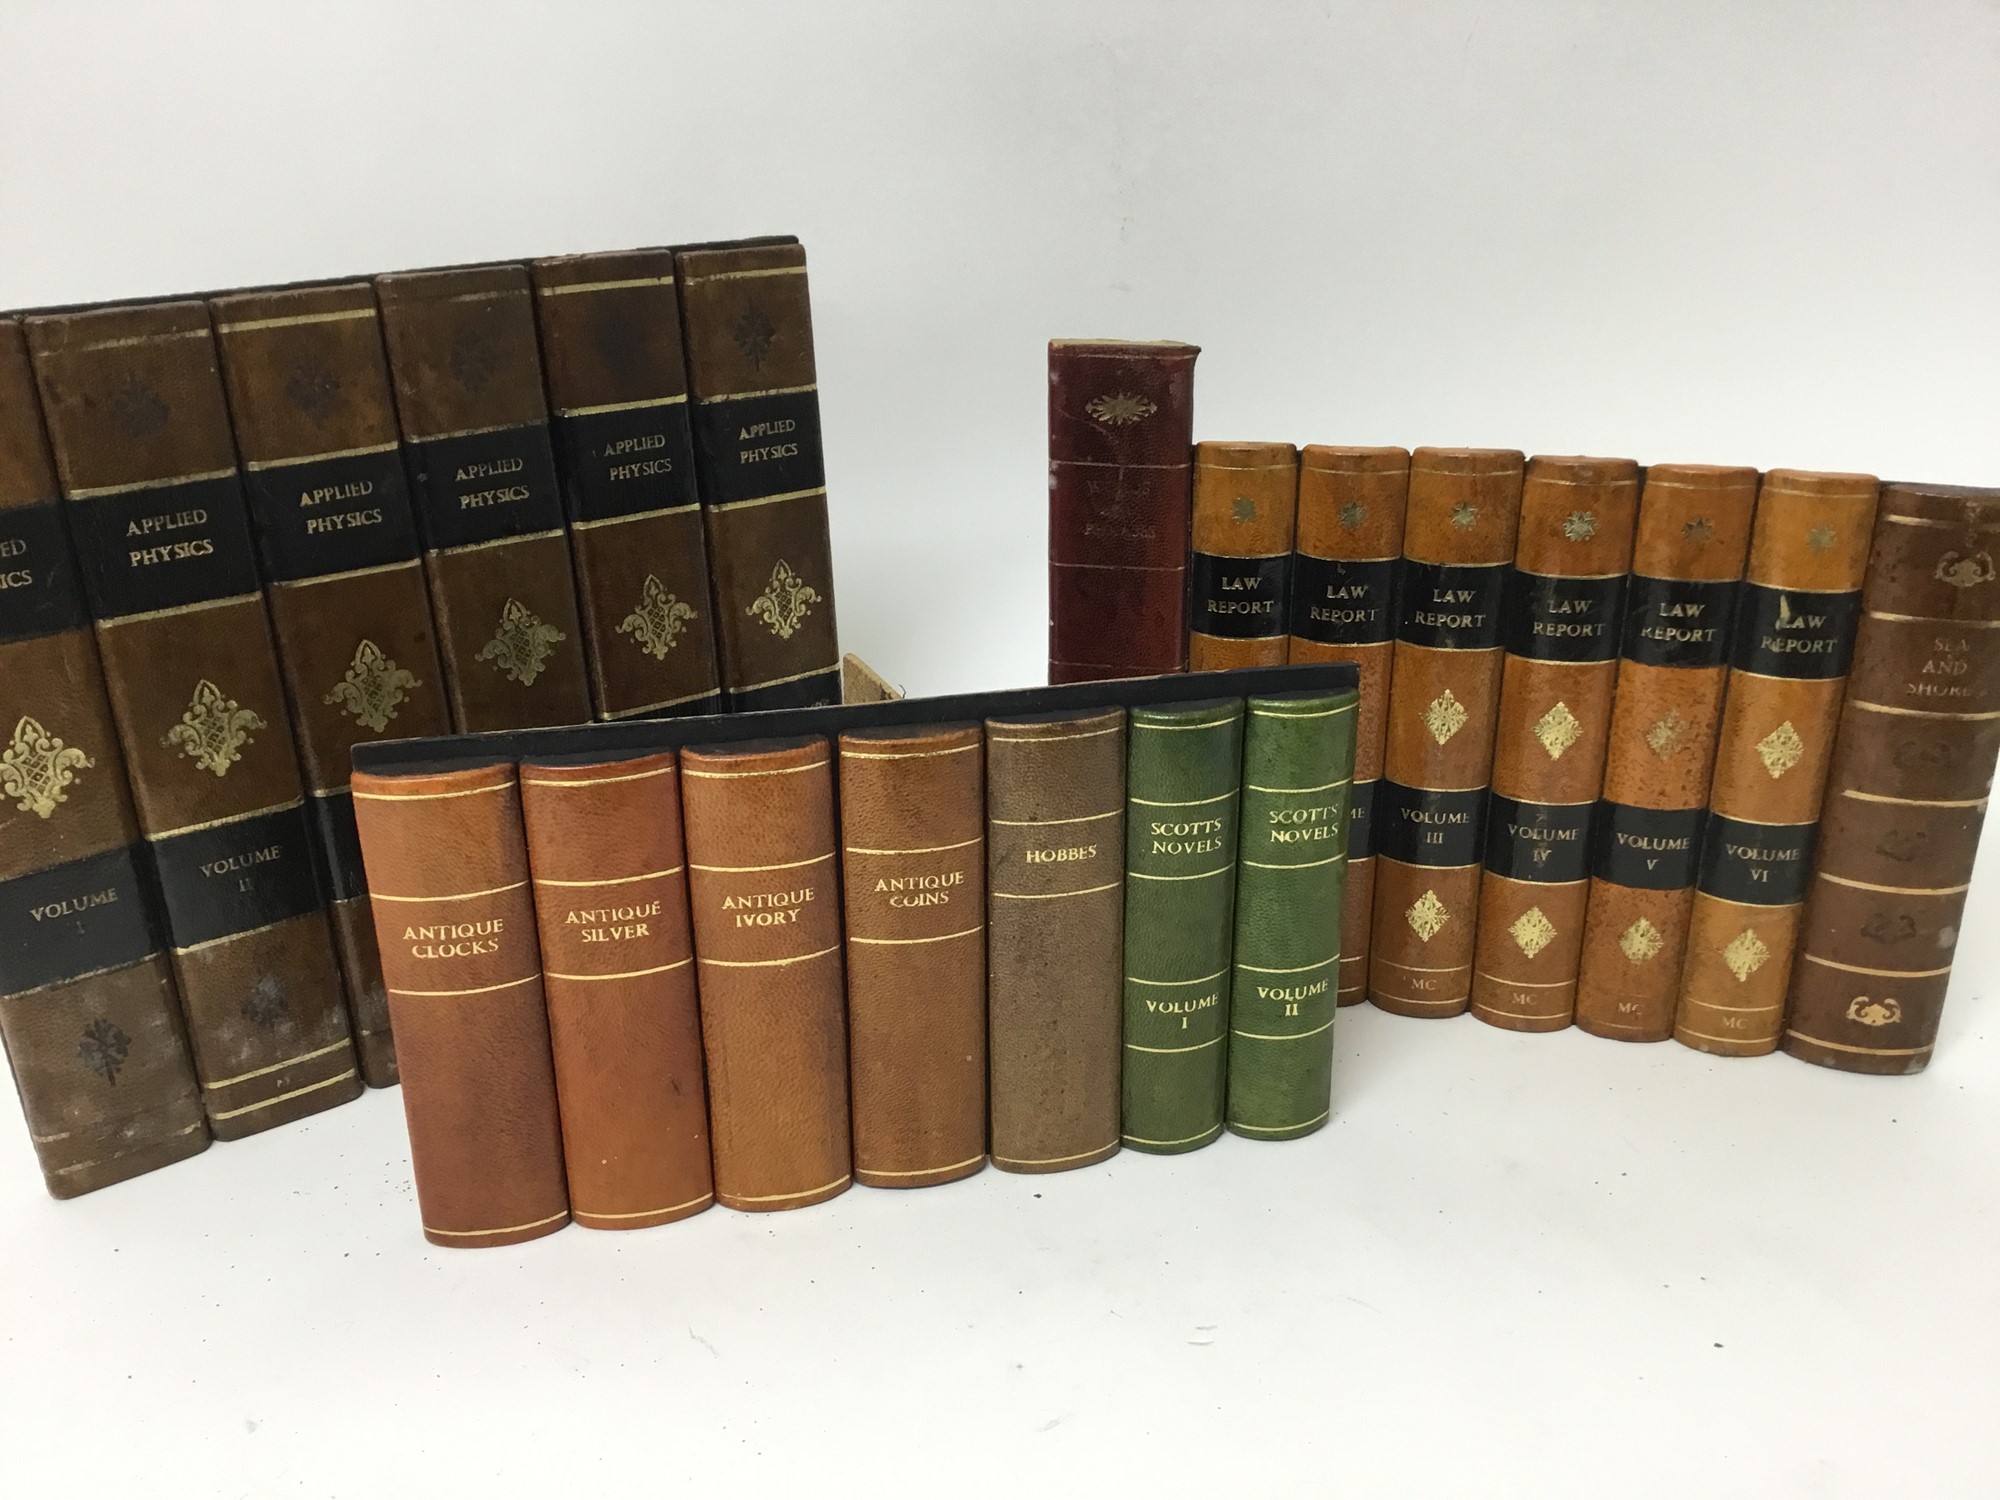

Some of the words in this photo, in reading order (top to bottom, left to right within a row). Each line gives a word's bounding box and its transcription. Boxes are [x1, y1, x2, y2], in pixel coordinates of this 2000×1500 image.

[739, 419, 796, 441] APPLIED
[604, 434, 666, 457] APPLIED
[740, 443, 799, 464] PHYSICS
[455, 458, 523, 481] APPLIED
[610, 459, 672, 481] PHYSICS
[300, 481, 373, 507] APPLIED
[459, 485, 529, 509] PHYSICS
[126, 509, 208, 537] APPLIED
[307, 509, 383, 535] PHYSICS
[130, 538, 214, 567] PHYSICS
[1221, 576, 1262, 591] LAW
[1326, 584, 1369, 600] LAW
[1433, 589, 1477, 604] LAW
[1207, 600, 1275, 615] REPORT
[1310, 606, 1380, 623] REPORT
[1548, 599, 1593, 614] LAW
[1659, 602, 1706, 618] LAW
[1415, 610, 1486, 628] REPORT
[1779, 613, 1828, 629] LAW
[1533, 621, 1606, 637] REPORT
[1641, 626, 1717, 643] REPORT
[1760, 636, 1837, 653] REPORT
[1922, 660, 1968, 675] AND
[1401, 807, 1471, 825] VOLUME
[1151, 818, 1222, 836] SCOTTS
[1270, 822, 1339, 844] NOVELS
[1507, 823, 1580, 840] VOLUME
[1152, 836, 1222, 855] NOVELS
[1426, 832, 1444, 845] III
[1617, 833, 1691, 851] VOLUME
[199, 845, 281, 878] VOLUME
[1026, 845, 1097, 864] HOBBES
[1533, 849, 1552, 862] IV
[1726, 844, 1800, 862] VOLUME
[1646, 859, 1658, 871] V
[874, 870, 965, 892] ANTIQUE
[1750, 868, 1769, 883] VI
[29, 887, 118, 922] VOLUME
[722, 886, 815, 911] ANTIQUE
[890, 890, 949, 908] COINS
[565, 901, 662, 925] ANTIQUE
[736, 908, 801, 929] IVORY
[403, 918, 504, 941] ANTIQUE
[581, 924, 650, 943] SILVER
[411, 938, 499, 959] CLOCKS
[1256, 979, 1329, 1001] VOLUME
[1411, 979, 1437, 991] MC
[1146, 992, 1219, 1014] VOLUME
[1512, 992, 1537, 1005] MC
[1285, 1003, 1299, 1016] II
[1181, 1017, 1188, 1029] I
[1722, 1016, 1749, 1030] MC
